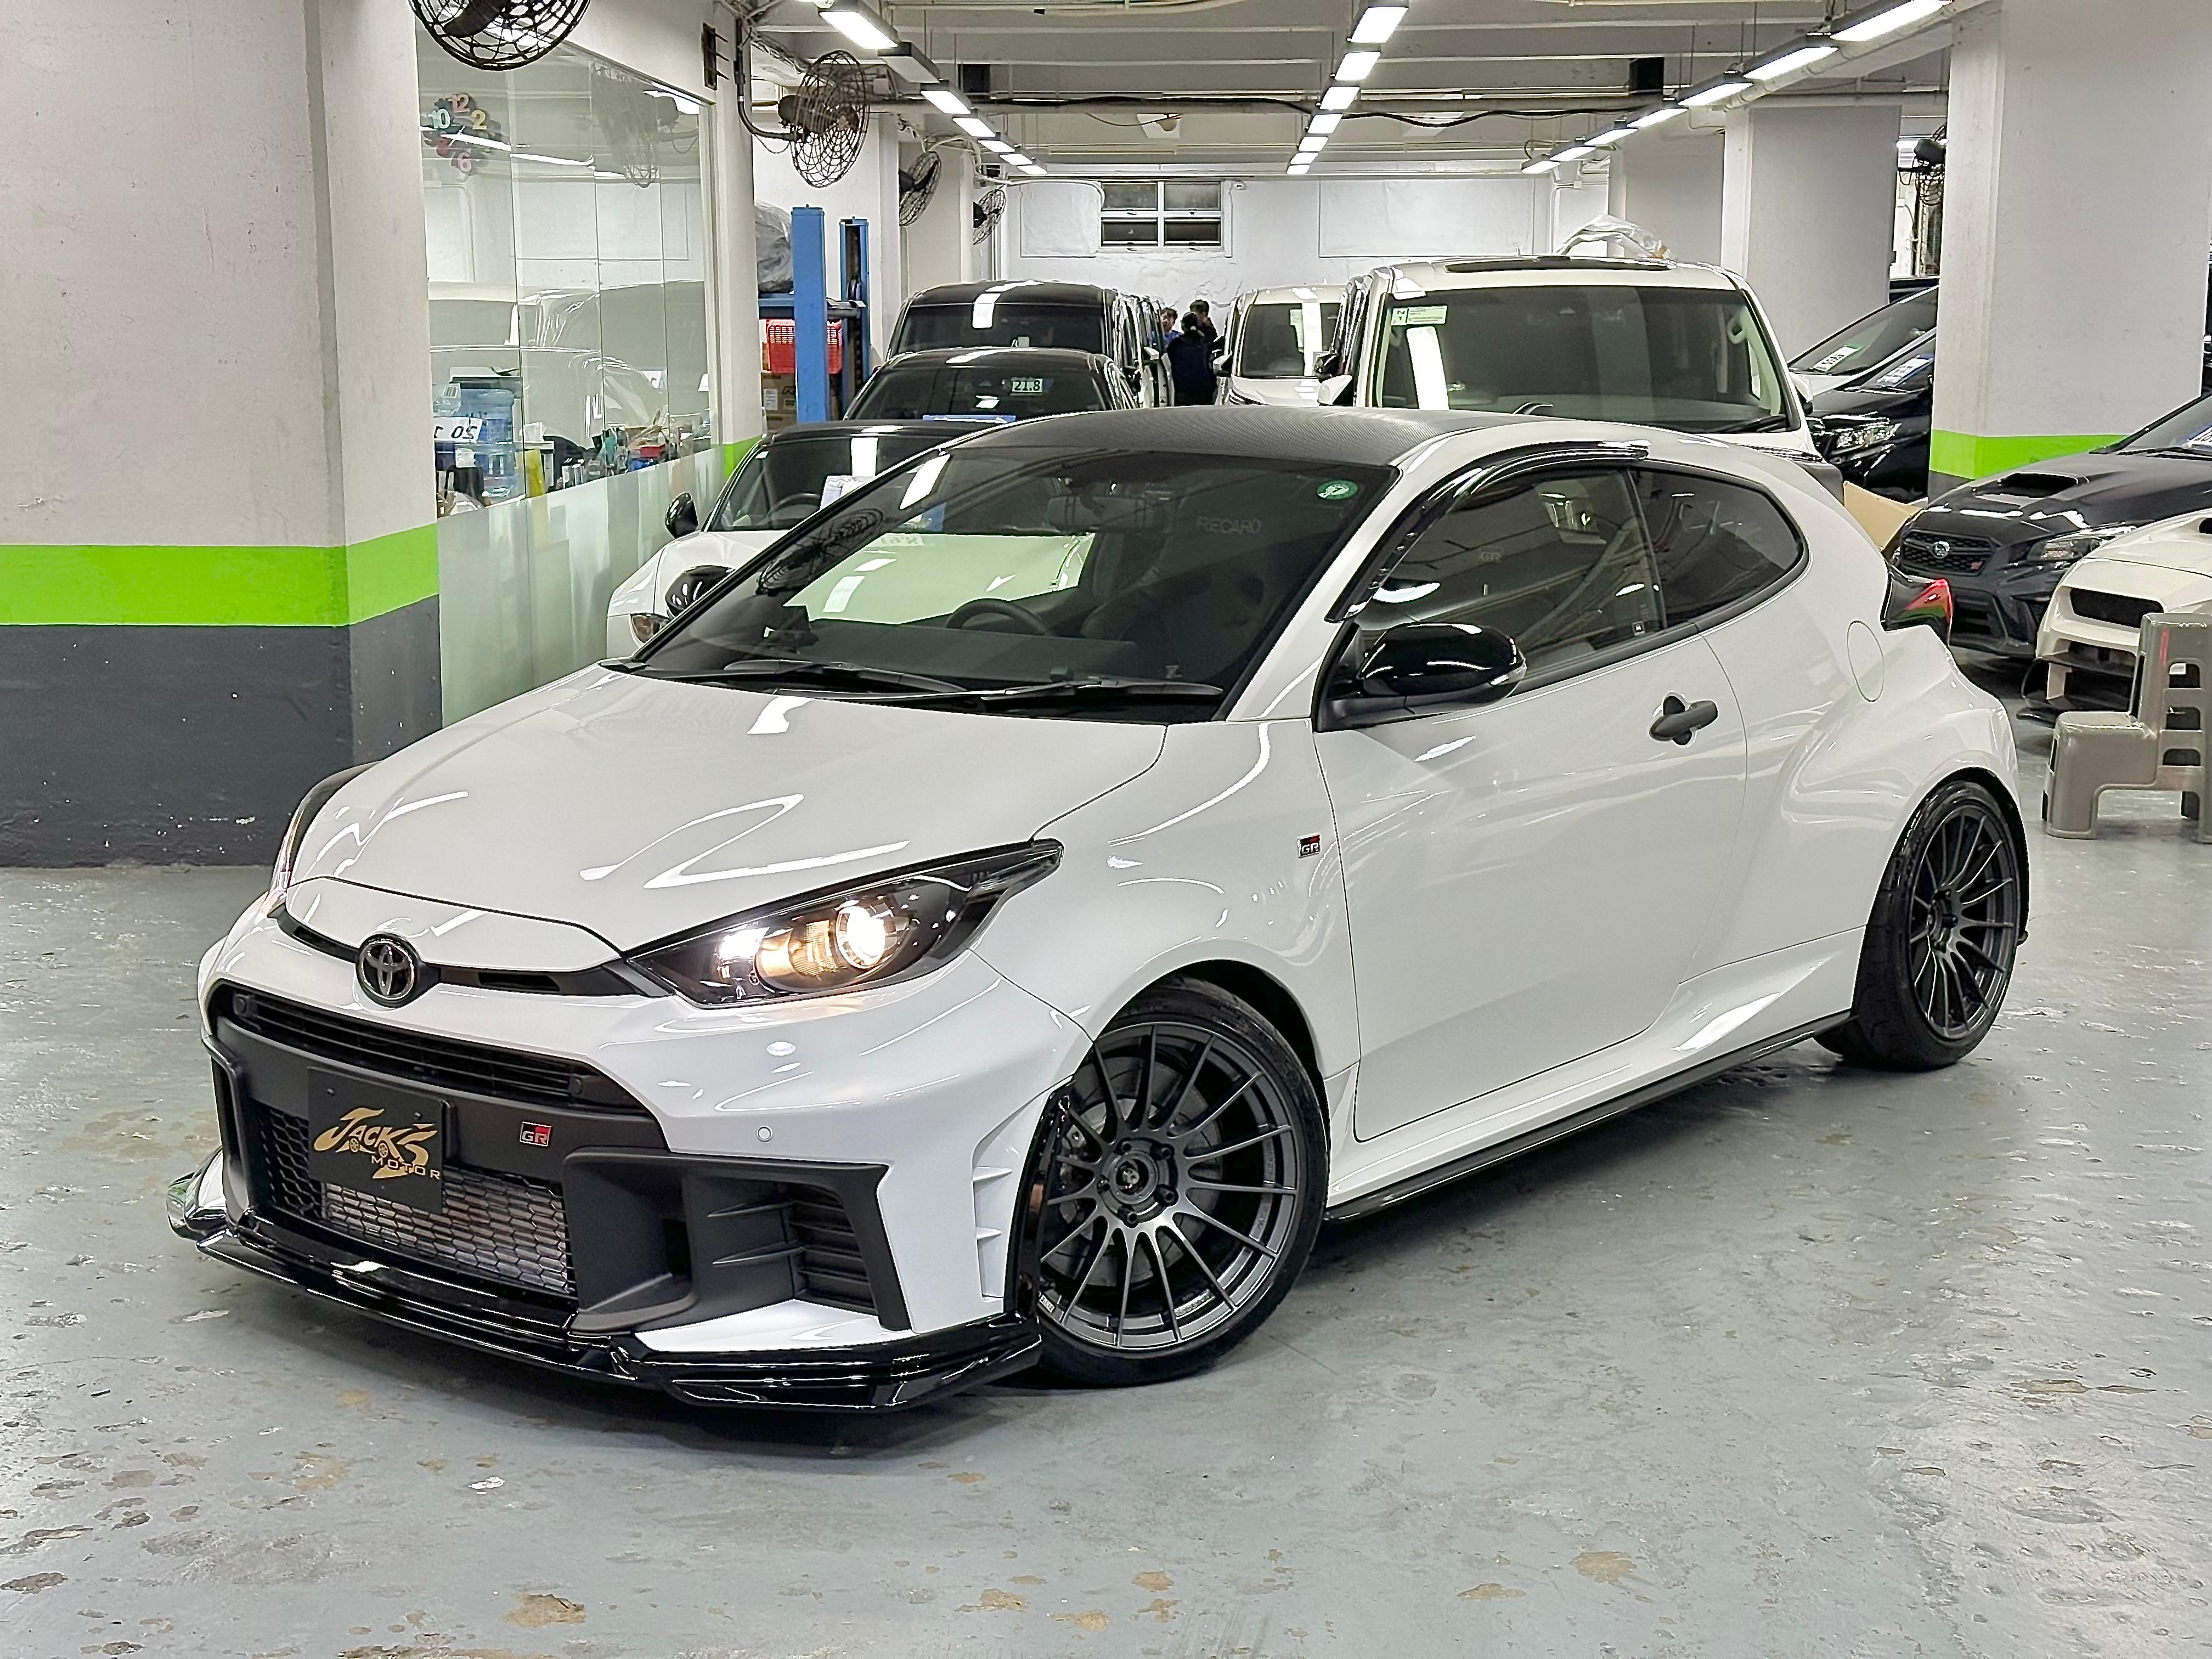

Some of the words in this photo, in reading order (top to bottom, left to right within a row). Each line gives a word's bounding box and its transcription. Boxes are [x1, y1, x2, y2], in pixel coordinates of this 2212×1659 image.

[449, 94, 470, 113] 12
[428, 109, 450, 129] 10
[471, 110, 487, 130] 2
[458, 152, 472, 172] 6
[1013, 380, 1041, 391] 21.8
[1197, 516, 1262, 534] RECARO
[1301, 842, 1319, 855] GR
[522, 1131, 548, 1144] GR
[371, 1155, 440, 1180] MOTOR
